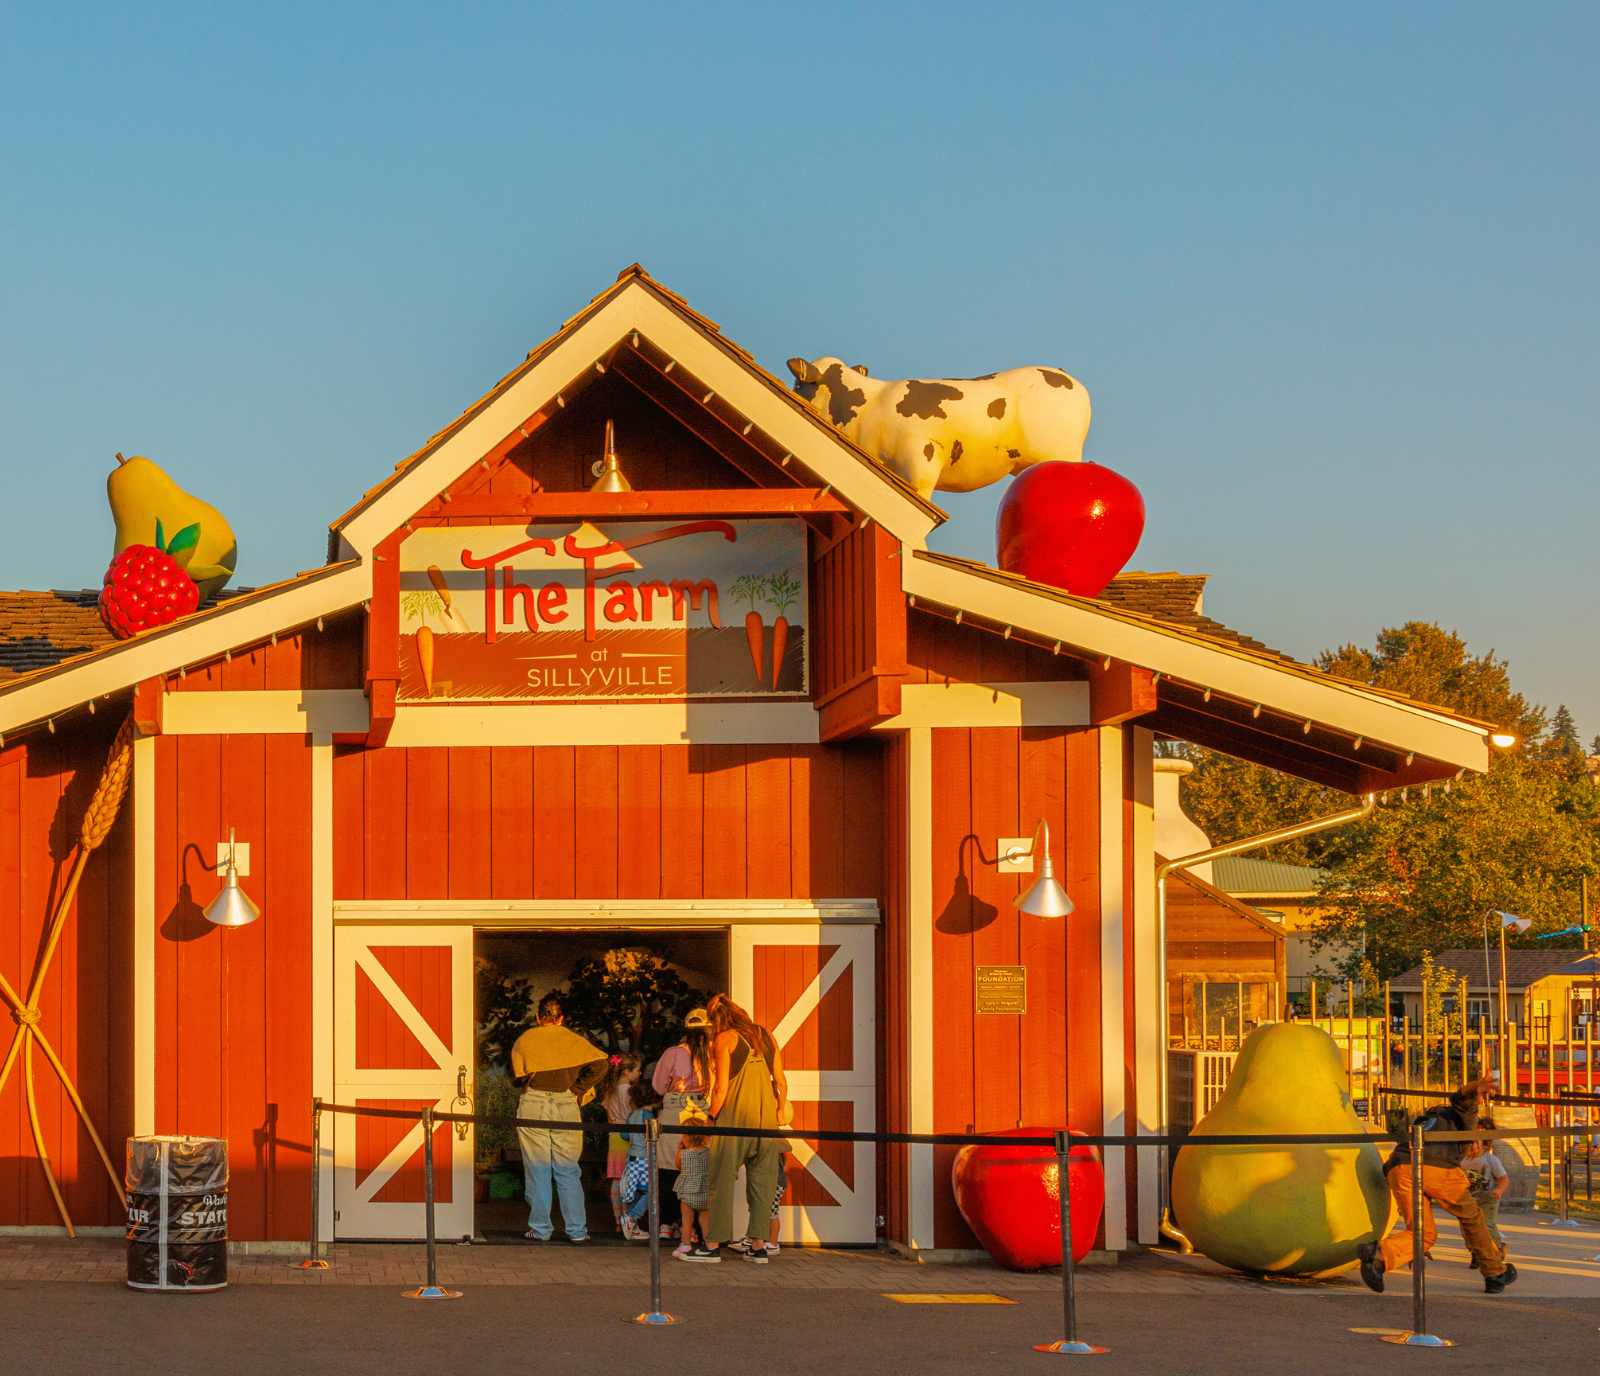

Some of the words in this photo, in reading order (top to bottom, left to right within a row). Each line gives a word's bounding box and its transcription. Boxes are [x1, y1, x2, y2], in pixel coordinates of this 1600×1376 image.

[461, 538, 568, 644] The
[564, 520, 737, 642] Farm
[590, 647, 608, 663] at
[526, 666, 674, 688] SILLYVILLE
